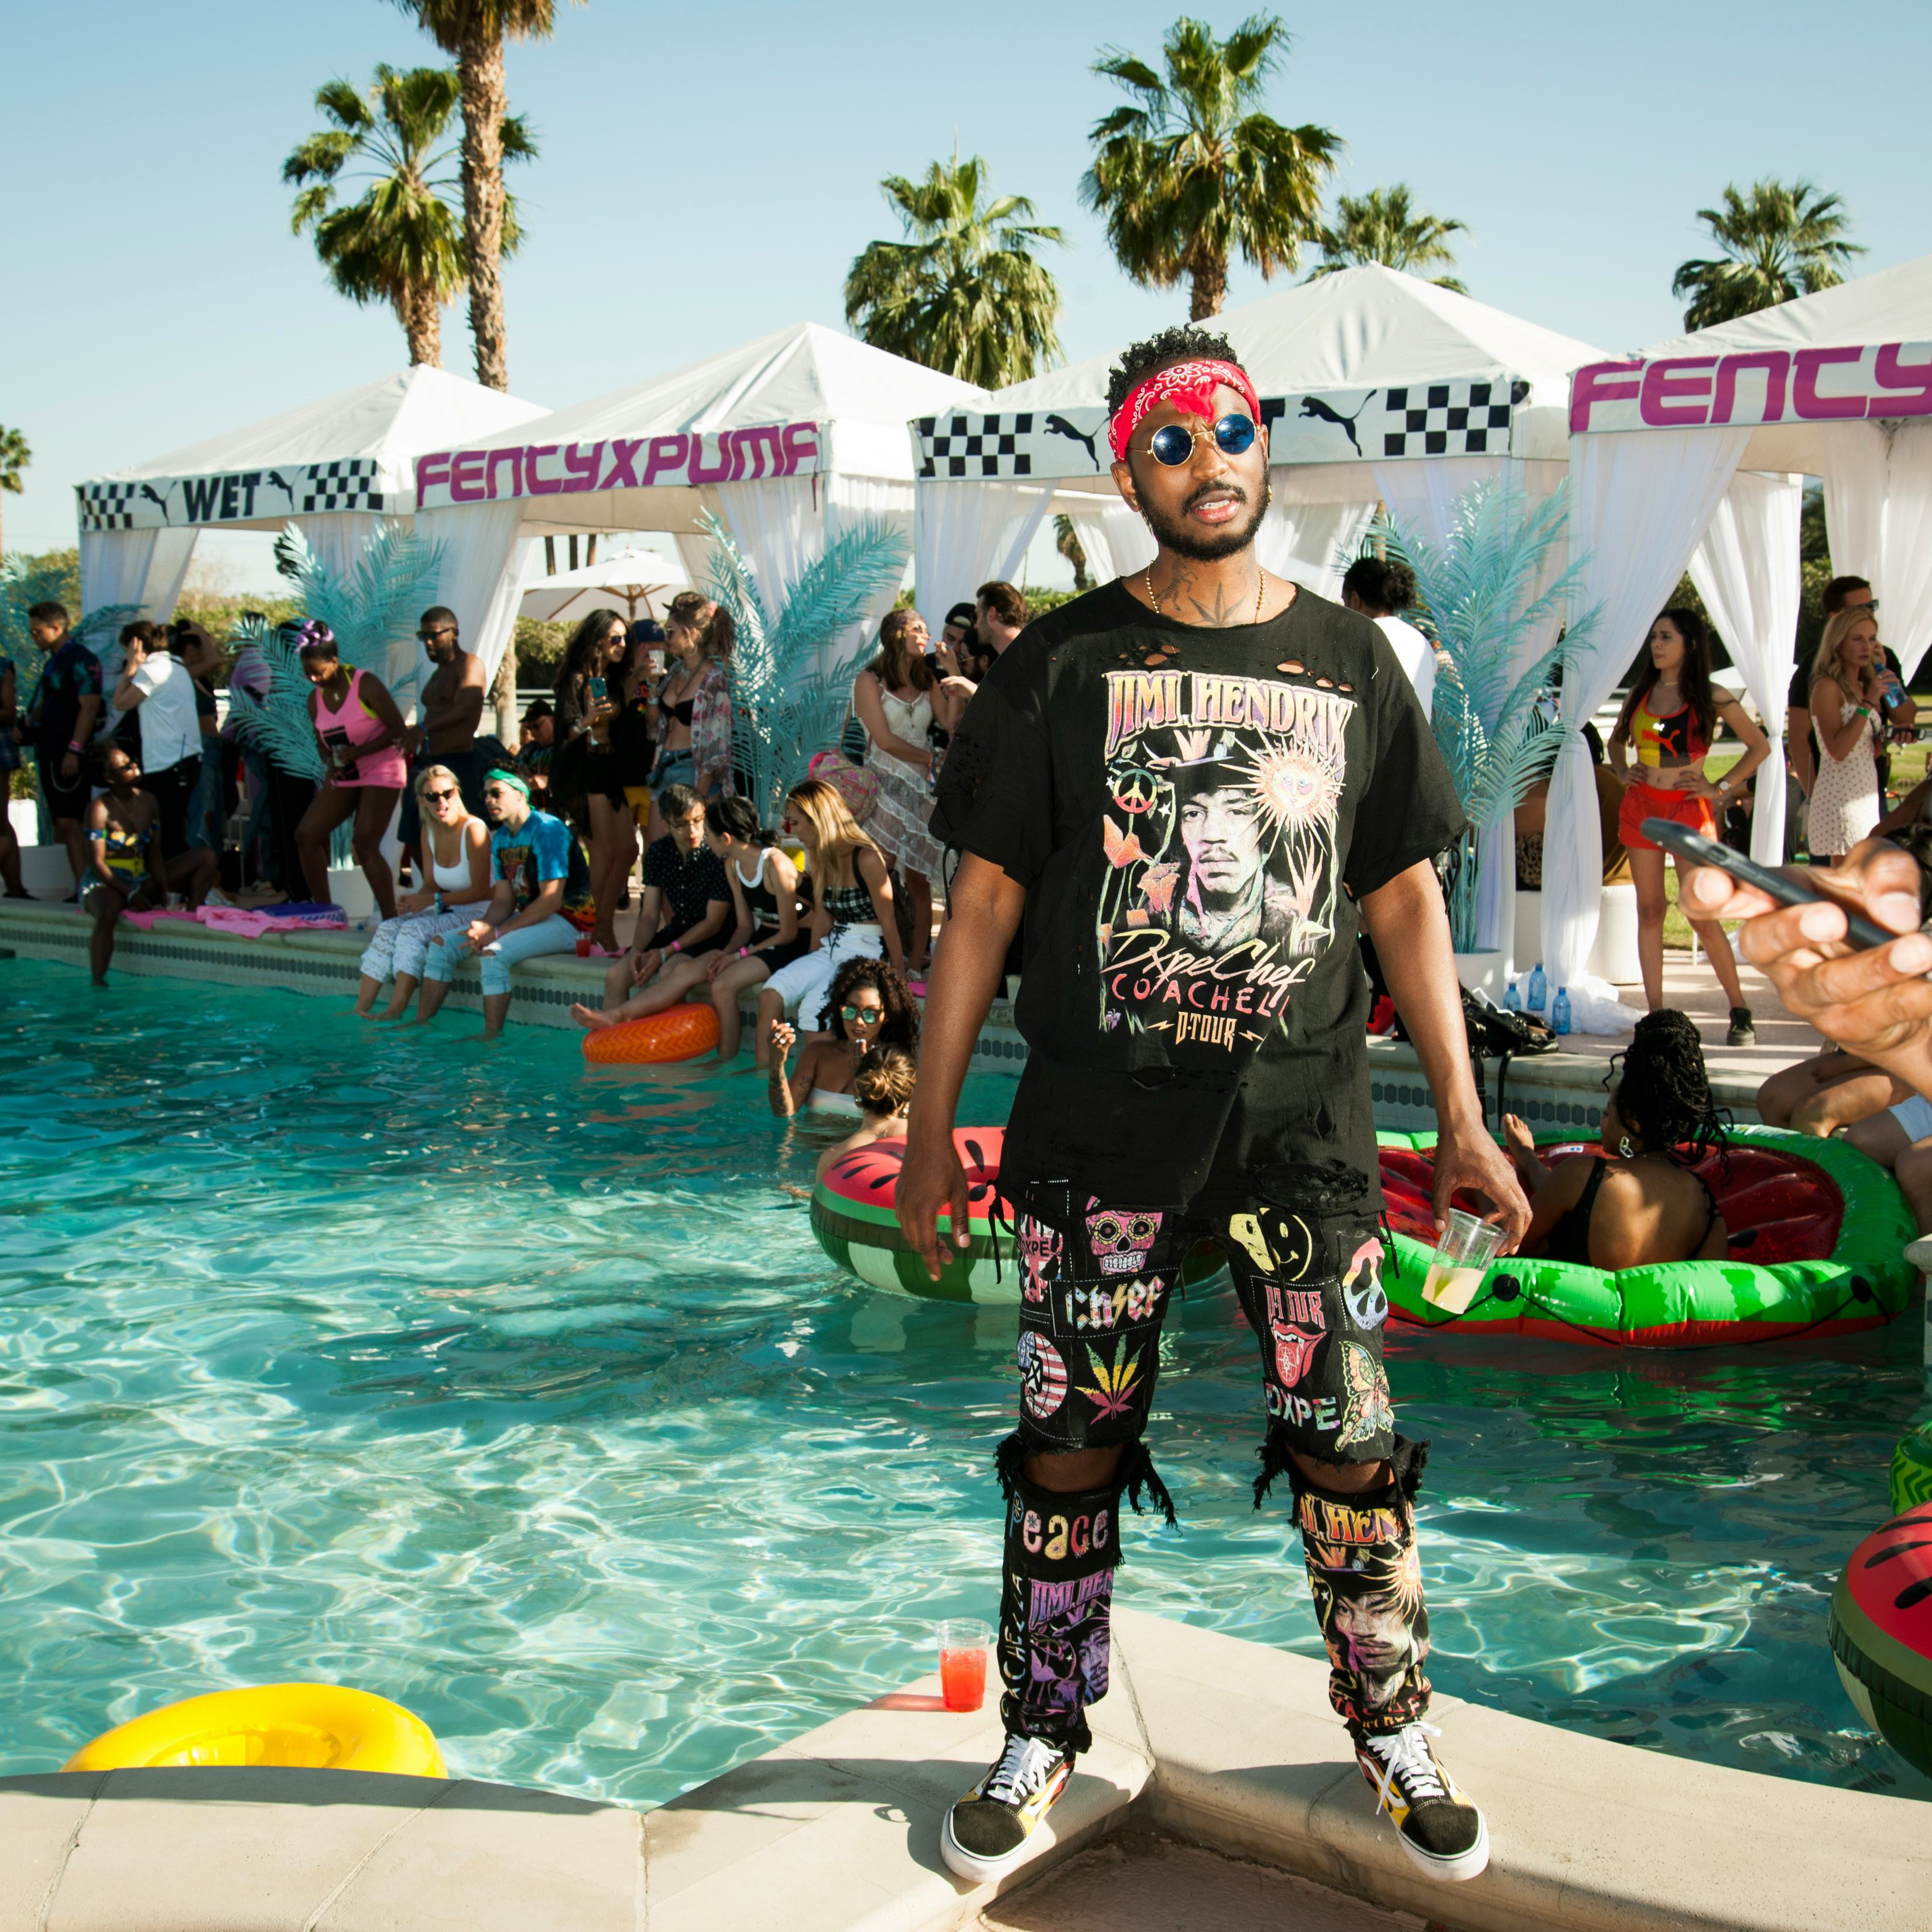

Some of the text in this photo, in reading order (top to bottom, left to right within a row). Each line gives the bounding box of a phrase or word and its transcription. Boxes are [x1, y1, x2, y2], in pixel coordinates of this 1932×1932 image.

[1570, 343, 1932, 432] FENTY
[182, 472, 262, 522] WET
[1105, 672, 1352, 782] JIMI HENDRIX
[1265, 1382, 1341, 1431] DXPE
[1029, 1578, 1075, 1632] JIMI
